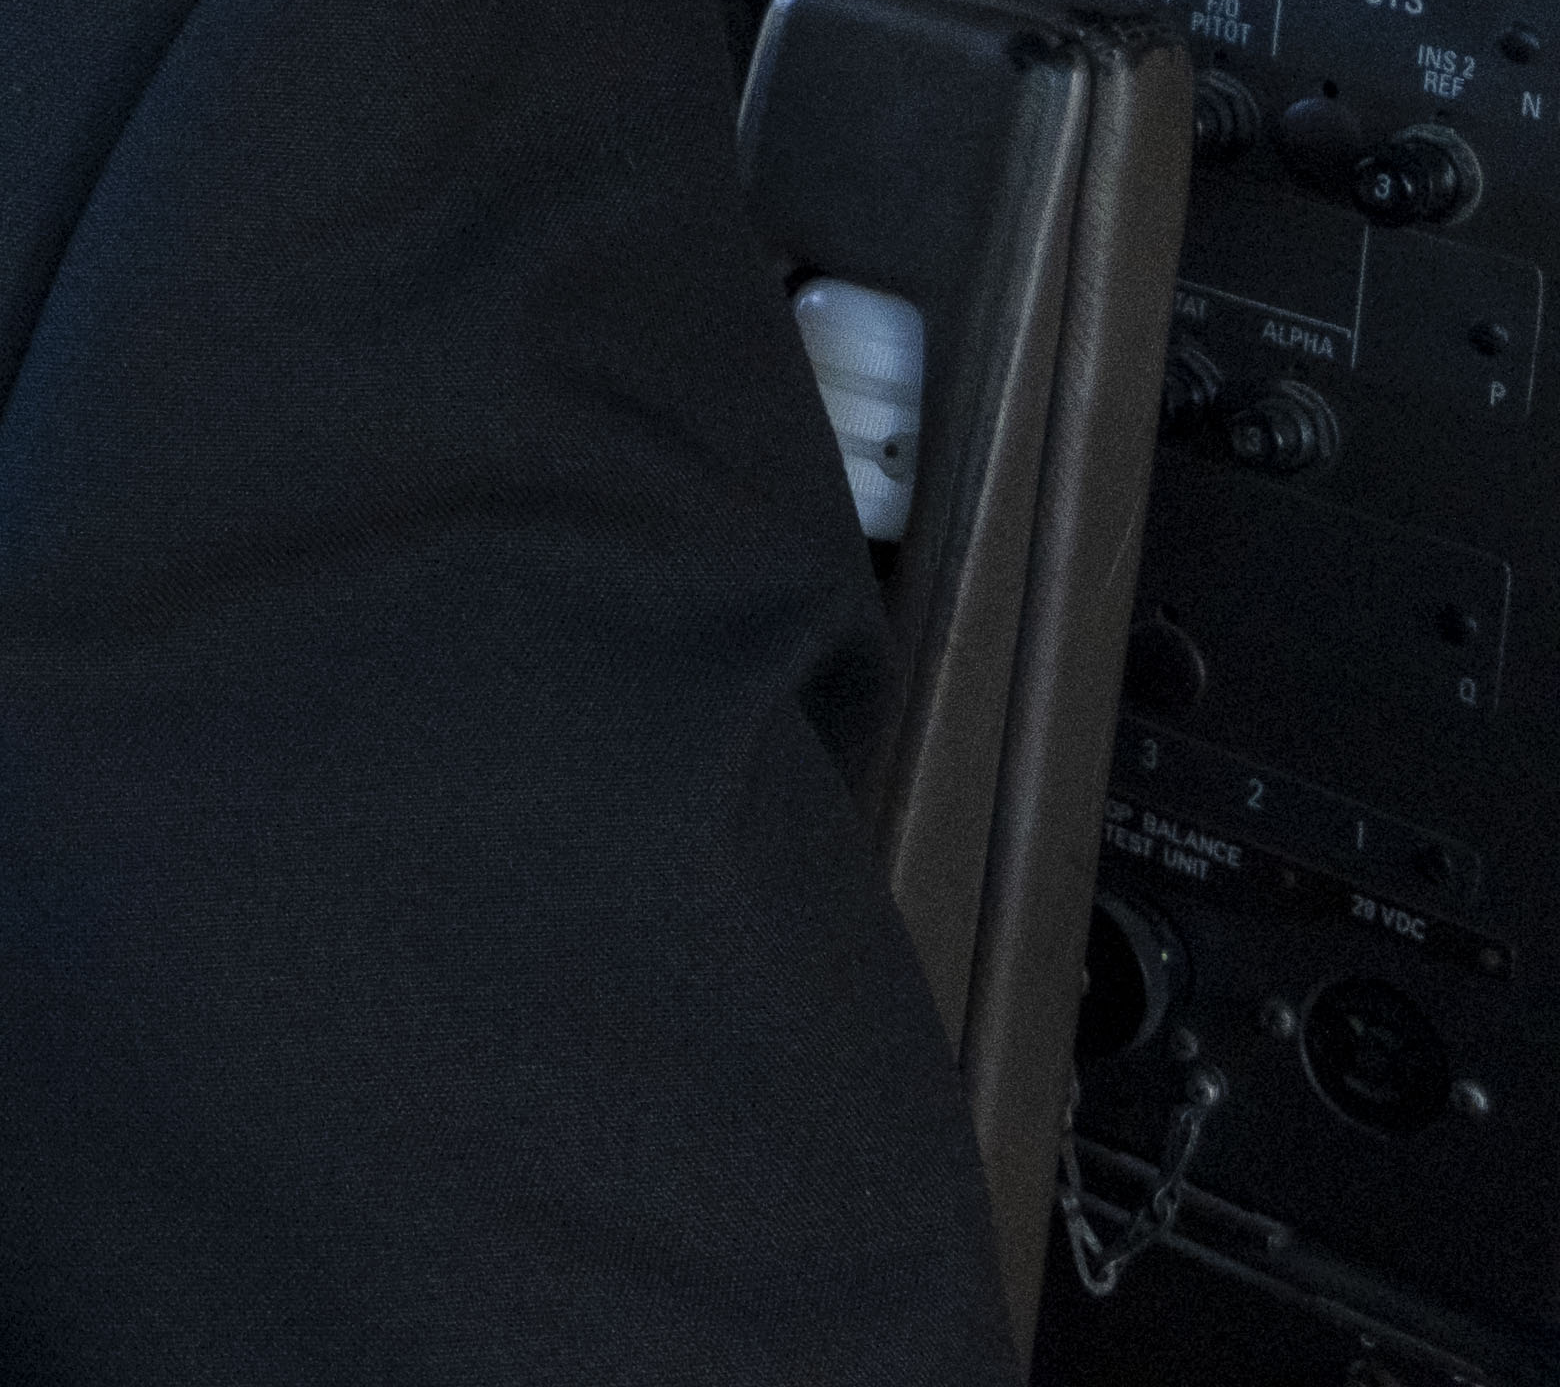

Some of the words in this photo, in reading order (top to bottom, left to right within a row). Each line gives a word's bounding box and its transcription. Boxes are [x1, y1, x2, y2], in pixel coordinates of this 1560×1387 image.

[1262, 321, 1334, 360] ALPHA
[1489, 381, 1507, 407] P
[1142, 737, 1158, 769] 3
[1246, 777, 1264, 811] 2
[1143, 812, 1243, 868] BALANCE
[1163, 845, 1210, 879] UNIT
[1380, 904, 1426, 941] VDC
